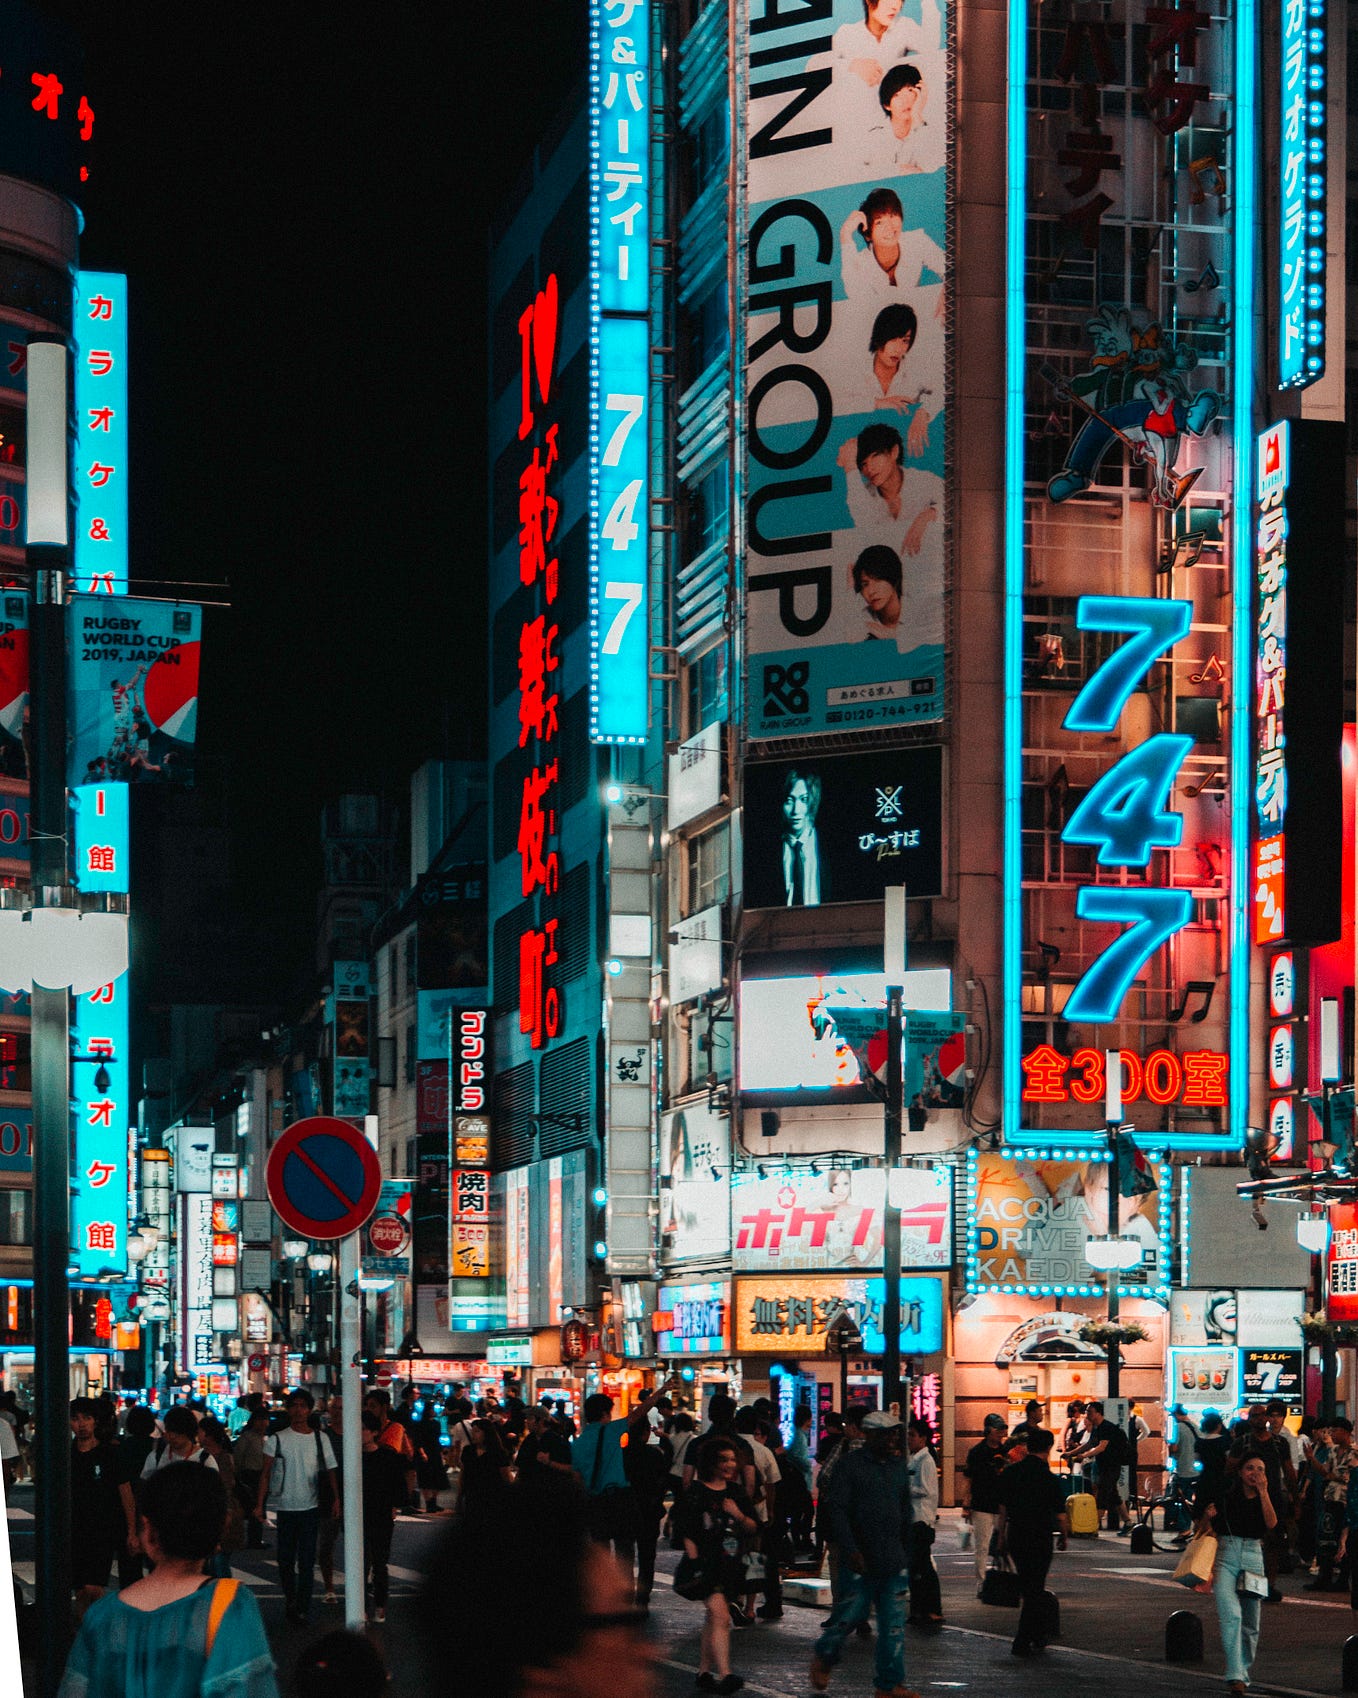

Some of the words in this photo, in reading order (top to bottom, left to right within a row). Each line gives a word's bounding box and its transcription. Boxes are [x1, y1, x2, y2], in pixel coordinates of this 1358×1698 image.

[746, 198, 834, 637] GROUP
[600, 393, 644, 654] 747
[83, 616, 142, 631] RUGBY
[83, 633, 145, 647] WORLD
[146, 635, 181, 650] CUP
[126, 650, 181, 666] JAPAN
[1060, 595, 1197, 1024] 747
[457, 1173, 486, 1212] 焼肉
[976, 1196, 1094, 1221] ACQUA
[974, 1227, 1082, 1250] DRIVE
[976, 1257, 1096, 1283] KAEDE
[1256, 1362, 1284, 1391] 7
